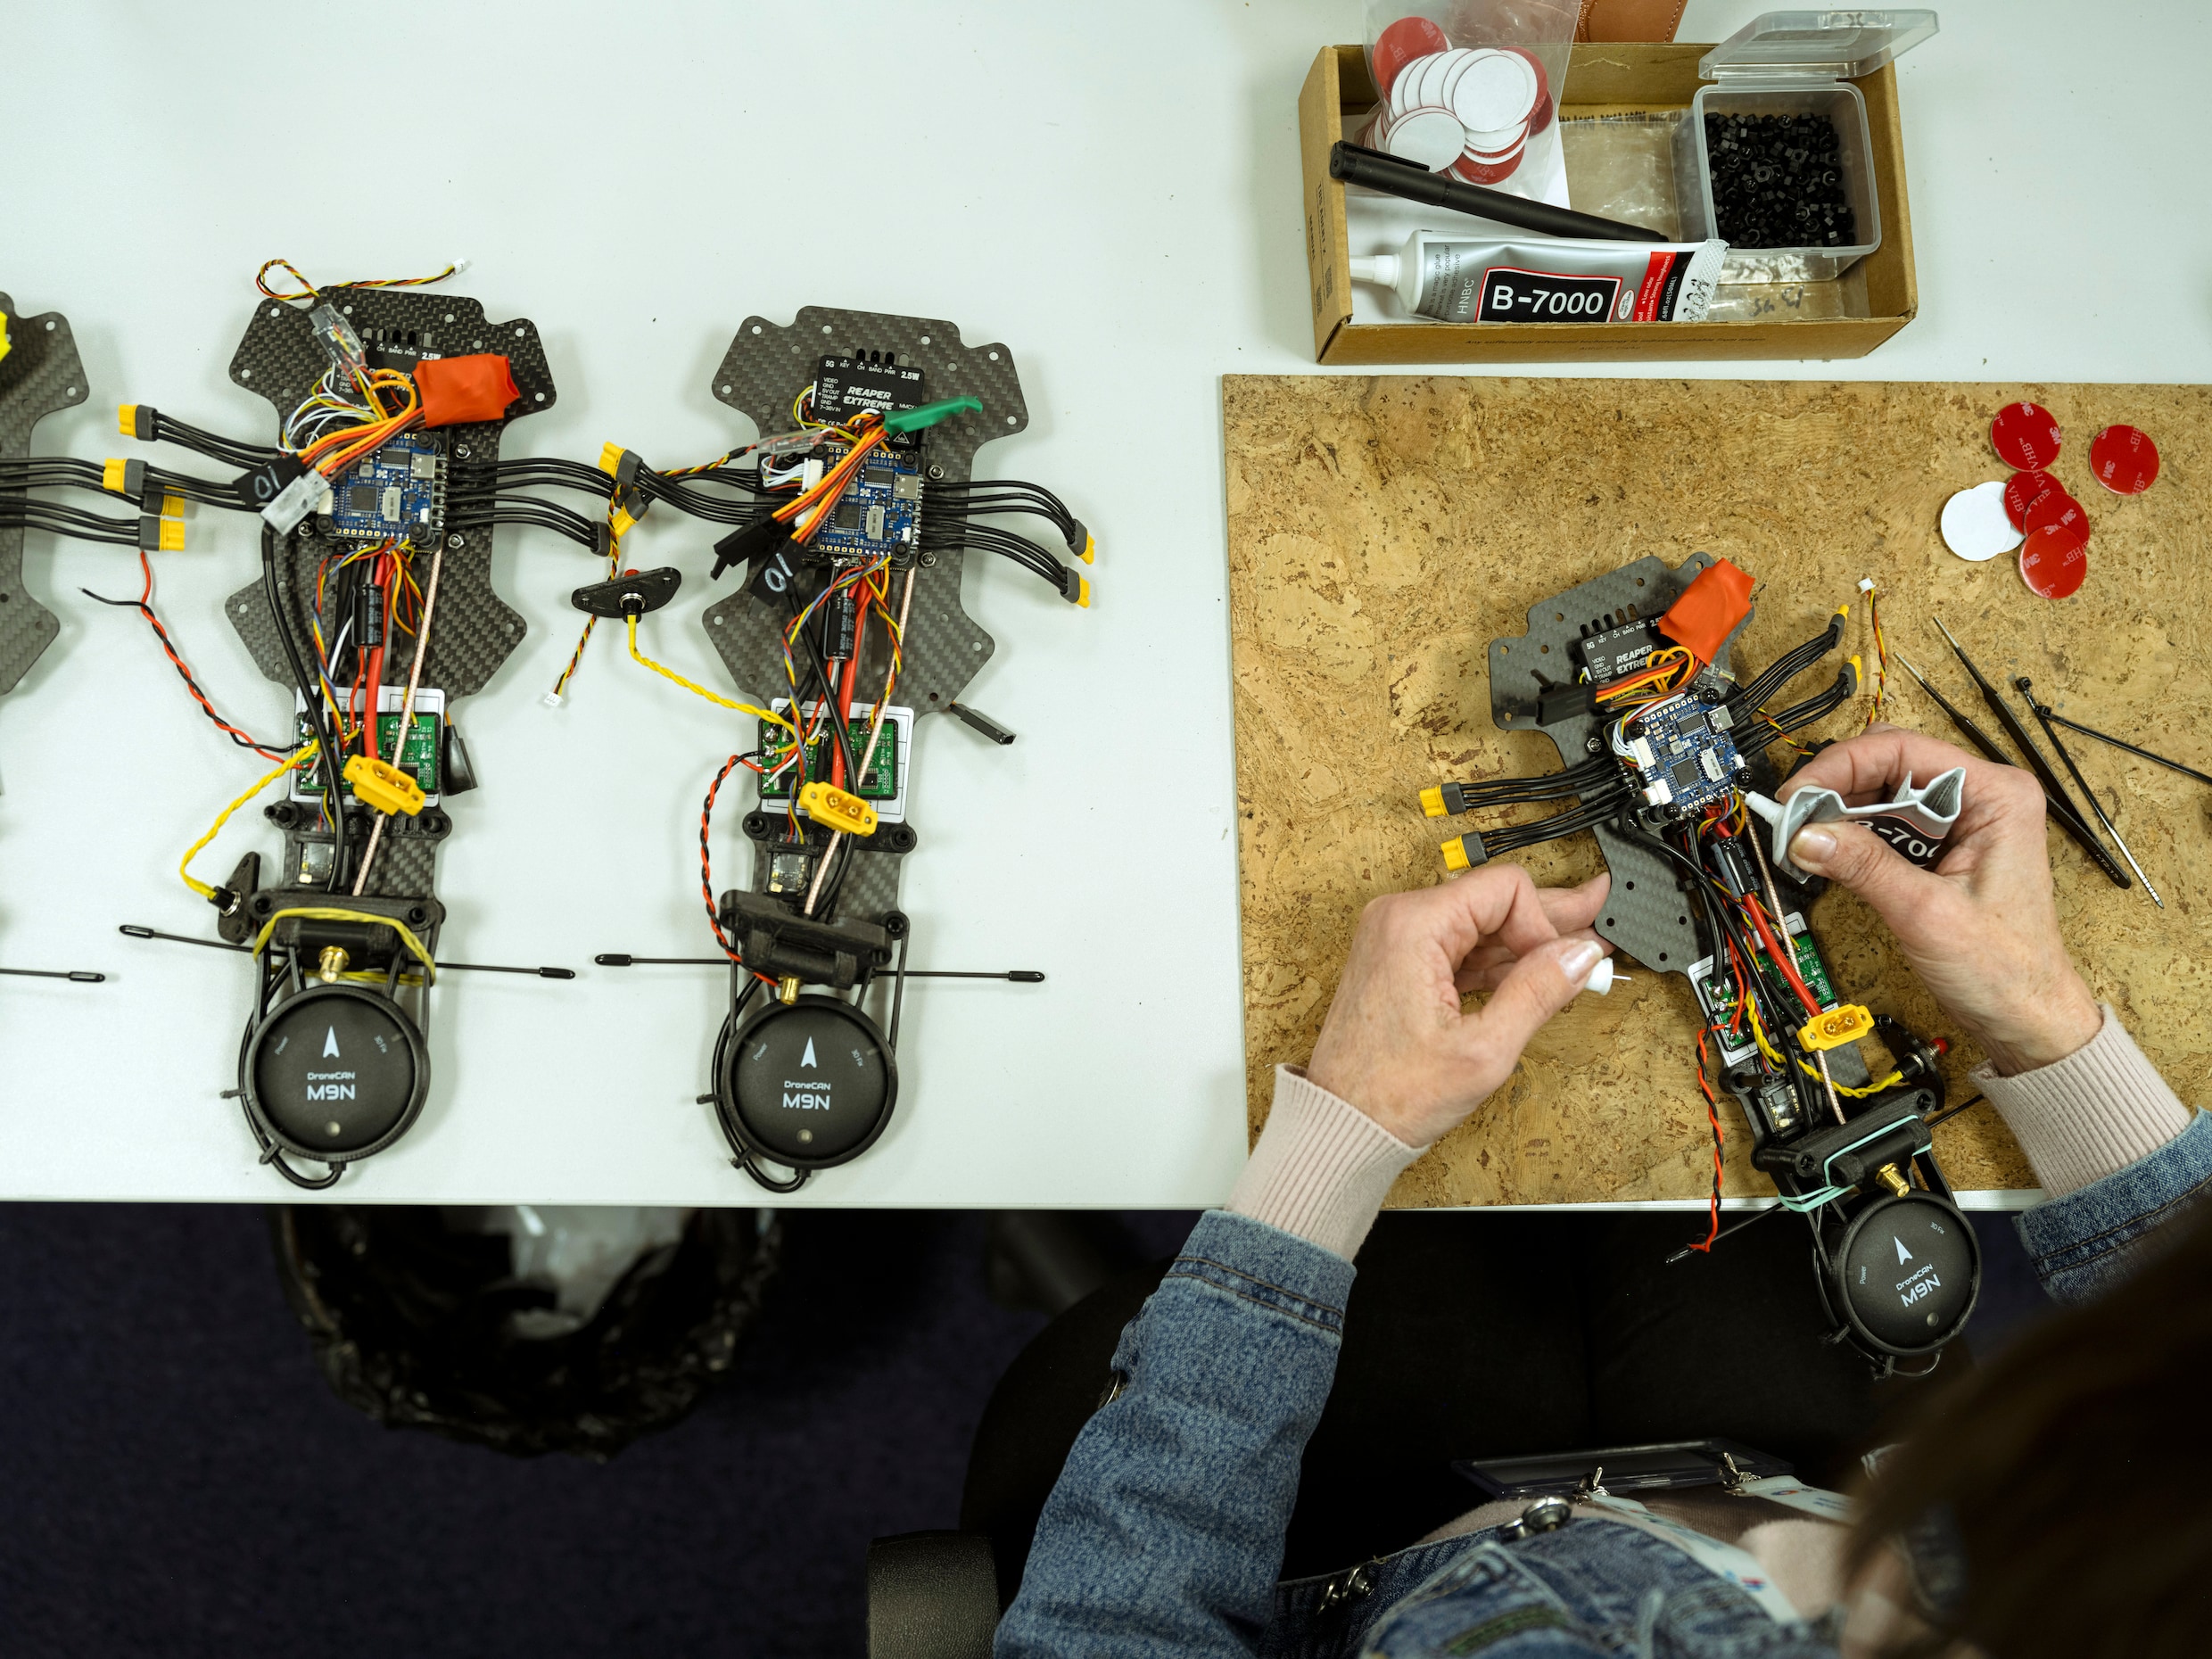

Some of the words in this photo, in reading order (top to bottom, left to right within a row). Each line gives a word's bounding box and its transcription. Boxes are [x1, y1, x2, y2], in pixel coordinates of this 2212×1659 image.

[1452, 253, 1460, 288] adhesive
[1650, 281, 1662, 299] Strong
[1656, 255, 1671, 282] toughness
[1492, 285, 1604, 315] B-7000
[1641, 289, 1650, 301] Low
[422, 352, 442, 360] 2.5W
[825, 359, 835, 368] 5G
[900, 371, 920, 381] 2.5W
[847, 385, 892, 400] REAPER
[843, 396, 895, 410] EXTREME
[2049, 426, 2061, 445] 3M
[2102, 460, 2116, 479] 3M
[2060, 508, 2076, 526] 3M
[2023, 553, 2041, 569] 3M
[1586, 641, 1596, 650] 5G
[1622, 627, 1635, 636] BAND
[1636, 623, 1647, 631] PWR
[1591, 656, 1605, 664] VIDEO
[1616, 644, 1653, 664] REAPER
[1594, 662, 1605, 670] GND
[1616, 656, 1648, 674] EXTRE
[1598, 671, 1613, 680] TRAMP
[274, 1036, 289, 1055] Power
[752, 1043, 767, 1061] Power
[307, 1071, 356, 1080] DroneCAN
[307, 1084, 356, 1101] M9N
[784, 1080, 831, 1091] DroneCAN
[782, 1092, 830, 1110] M9N
[1930, 1222, 1938, 1230] 3D
[1936, 1226, 1945, 1235] Fix
[1895, 1263, 1934, 1292] DroneCAN
[1901, 1273, 1941, 1308] M9N
